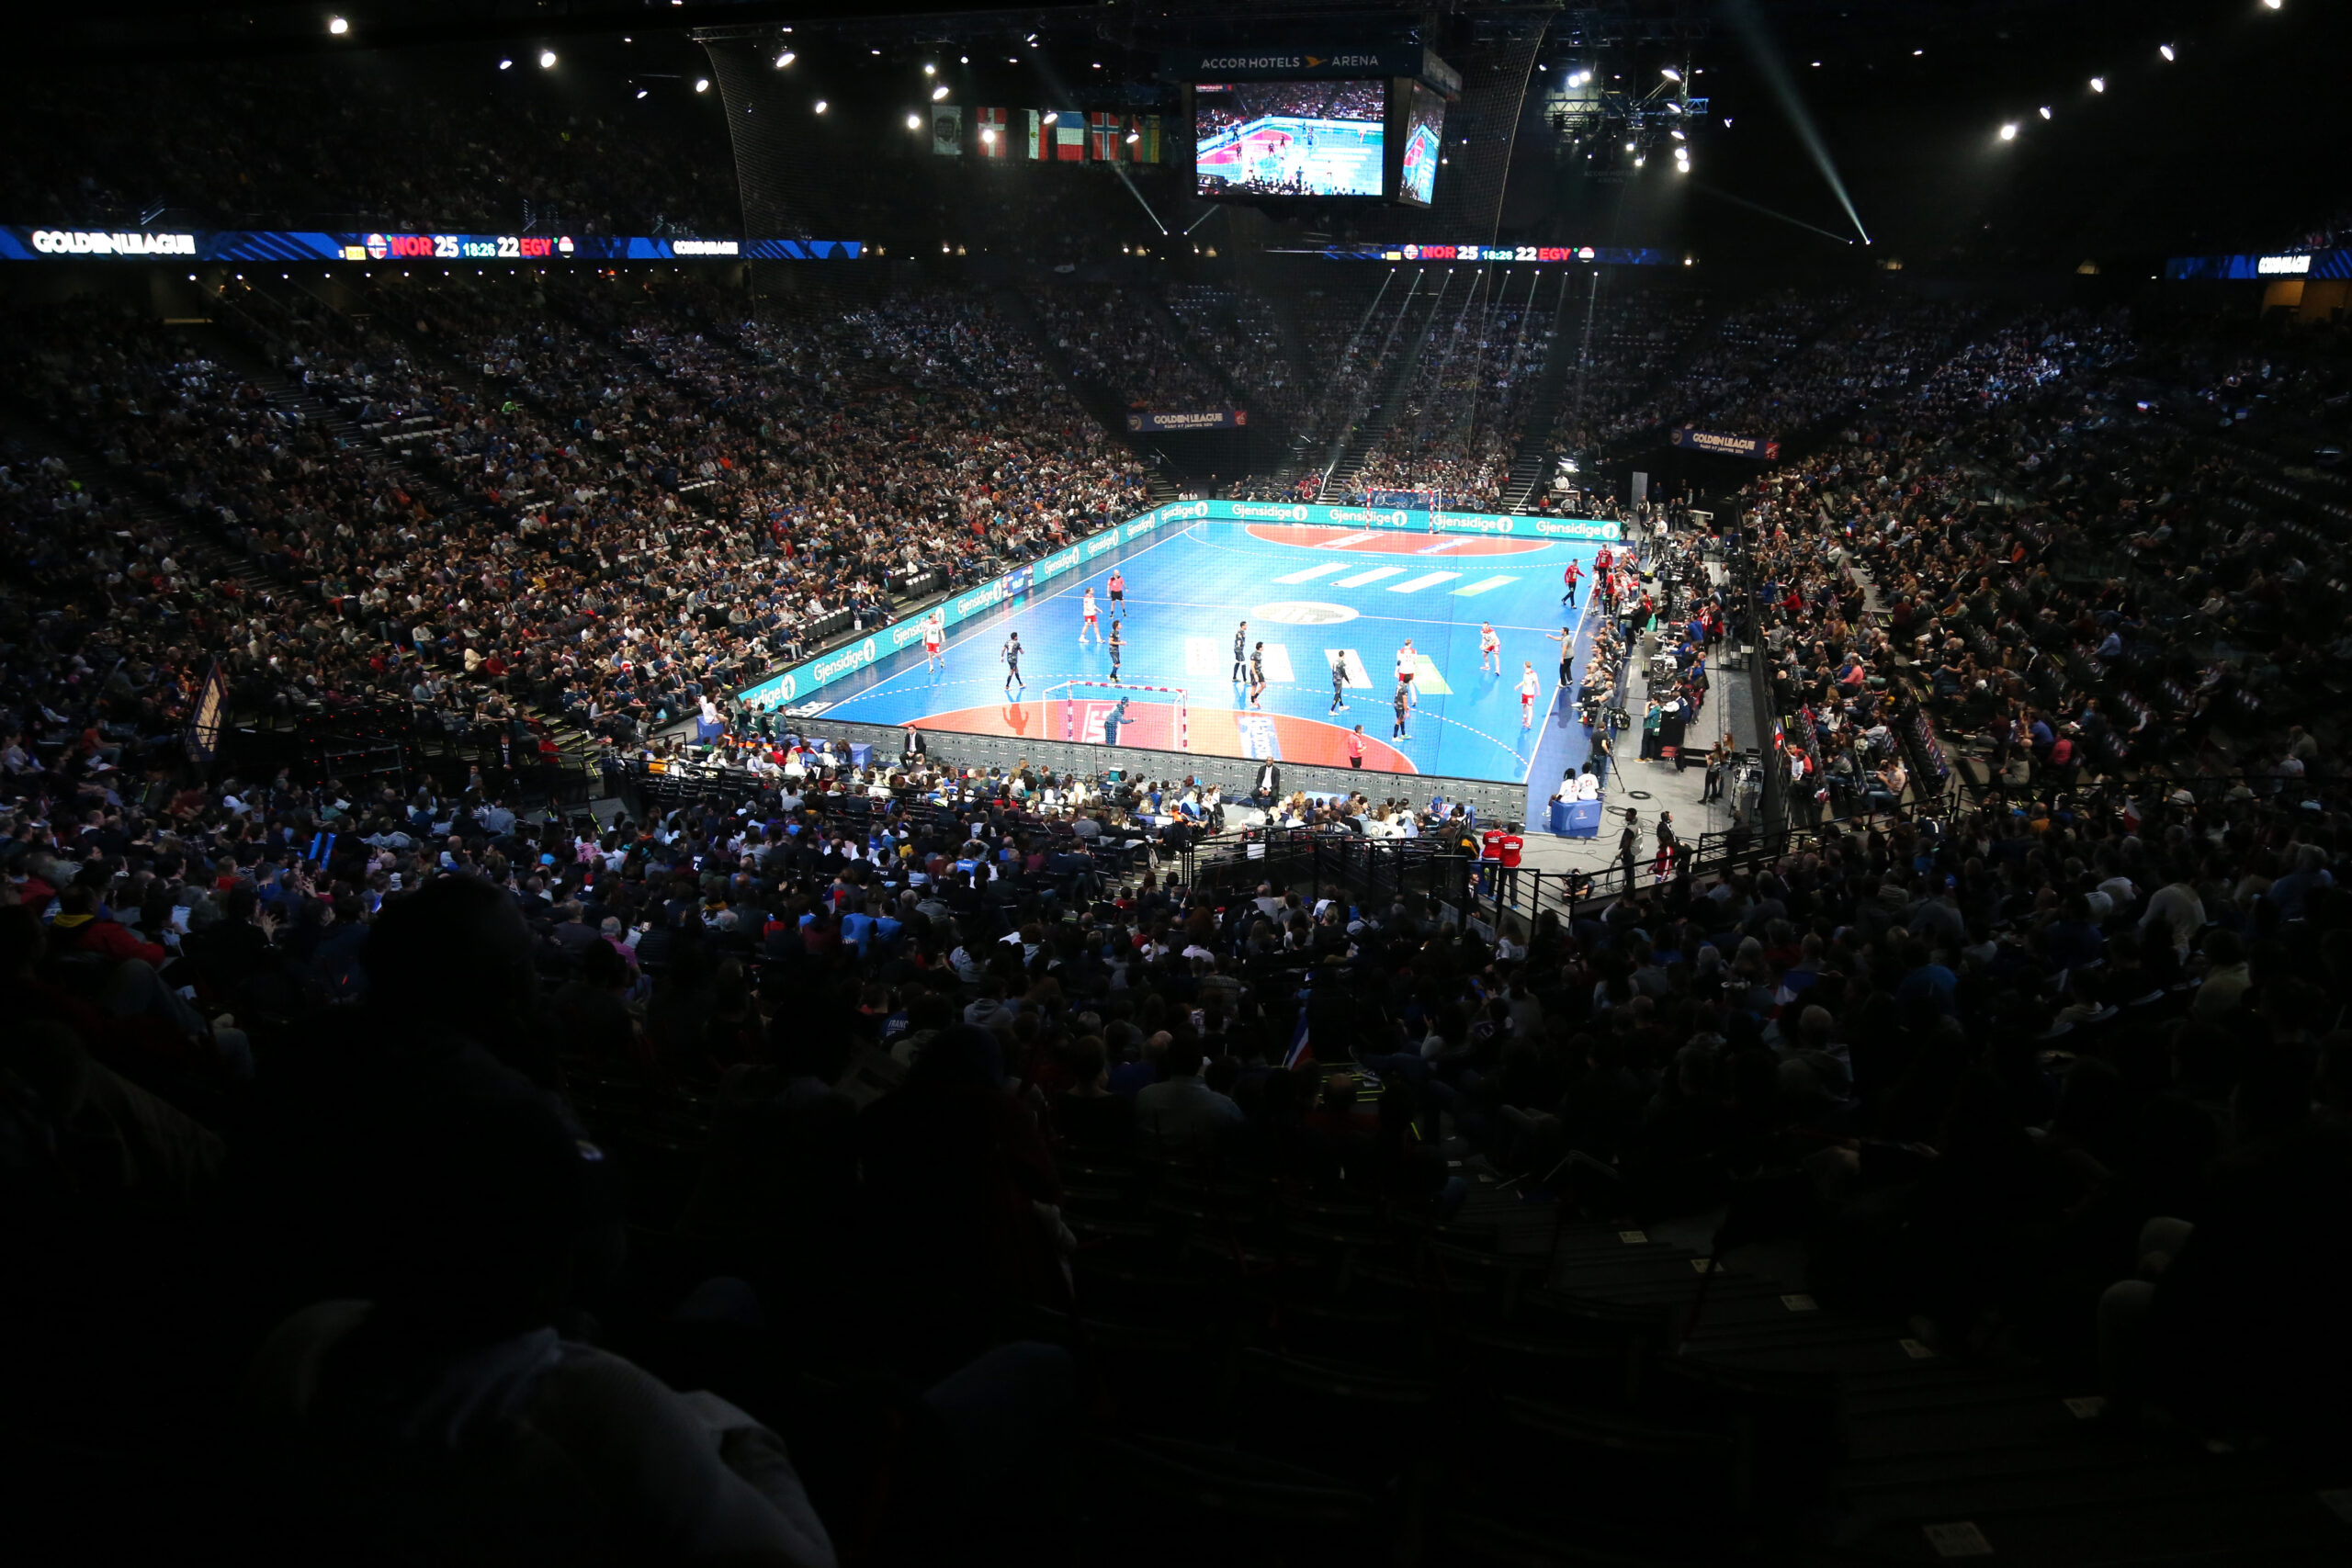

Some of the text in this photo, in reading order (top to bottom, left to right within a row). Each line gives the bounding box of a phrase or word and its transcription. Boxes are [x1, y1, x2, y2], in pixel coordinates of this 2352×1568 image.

[1332, 55, 1378, 66] ARENA
[390, 236, 552, 257] NOR 25 18:26 22 EGY
[1421, 245, 1571, 261] NOR 25 18:26 22 EGY
[1154, 412, 1223, 424] GOLDEN LEAGUE
[1692, 433, 1724, 446] GOLDEN
[1724, 436, 1756, 450] LEAGUE
[1232, 503, 1292, 520] Gjensidige
[1329, 509, 1391, 525] Gjensidige
[1432, 514, 1497, 531] Gjensidige
[1536, 521, 1602, 537] Gjensidige
[1087, 535, 1114, 557] Gjensidige
[1044, 553, 1073, 577] Gjensidige
[957, 586, 994, 616] Gjensidige
[813, 646, 864, 683] Gjensidige
